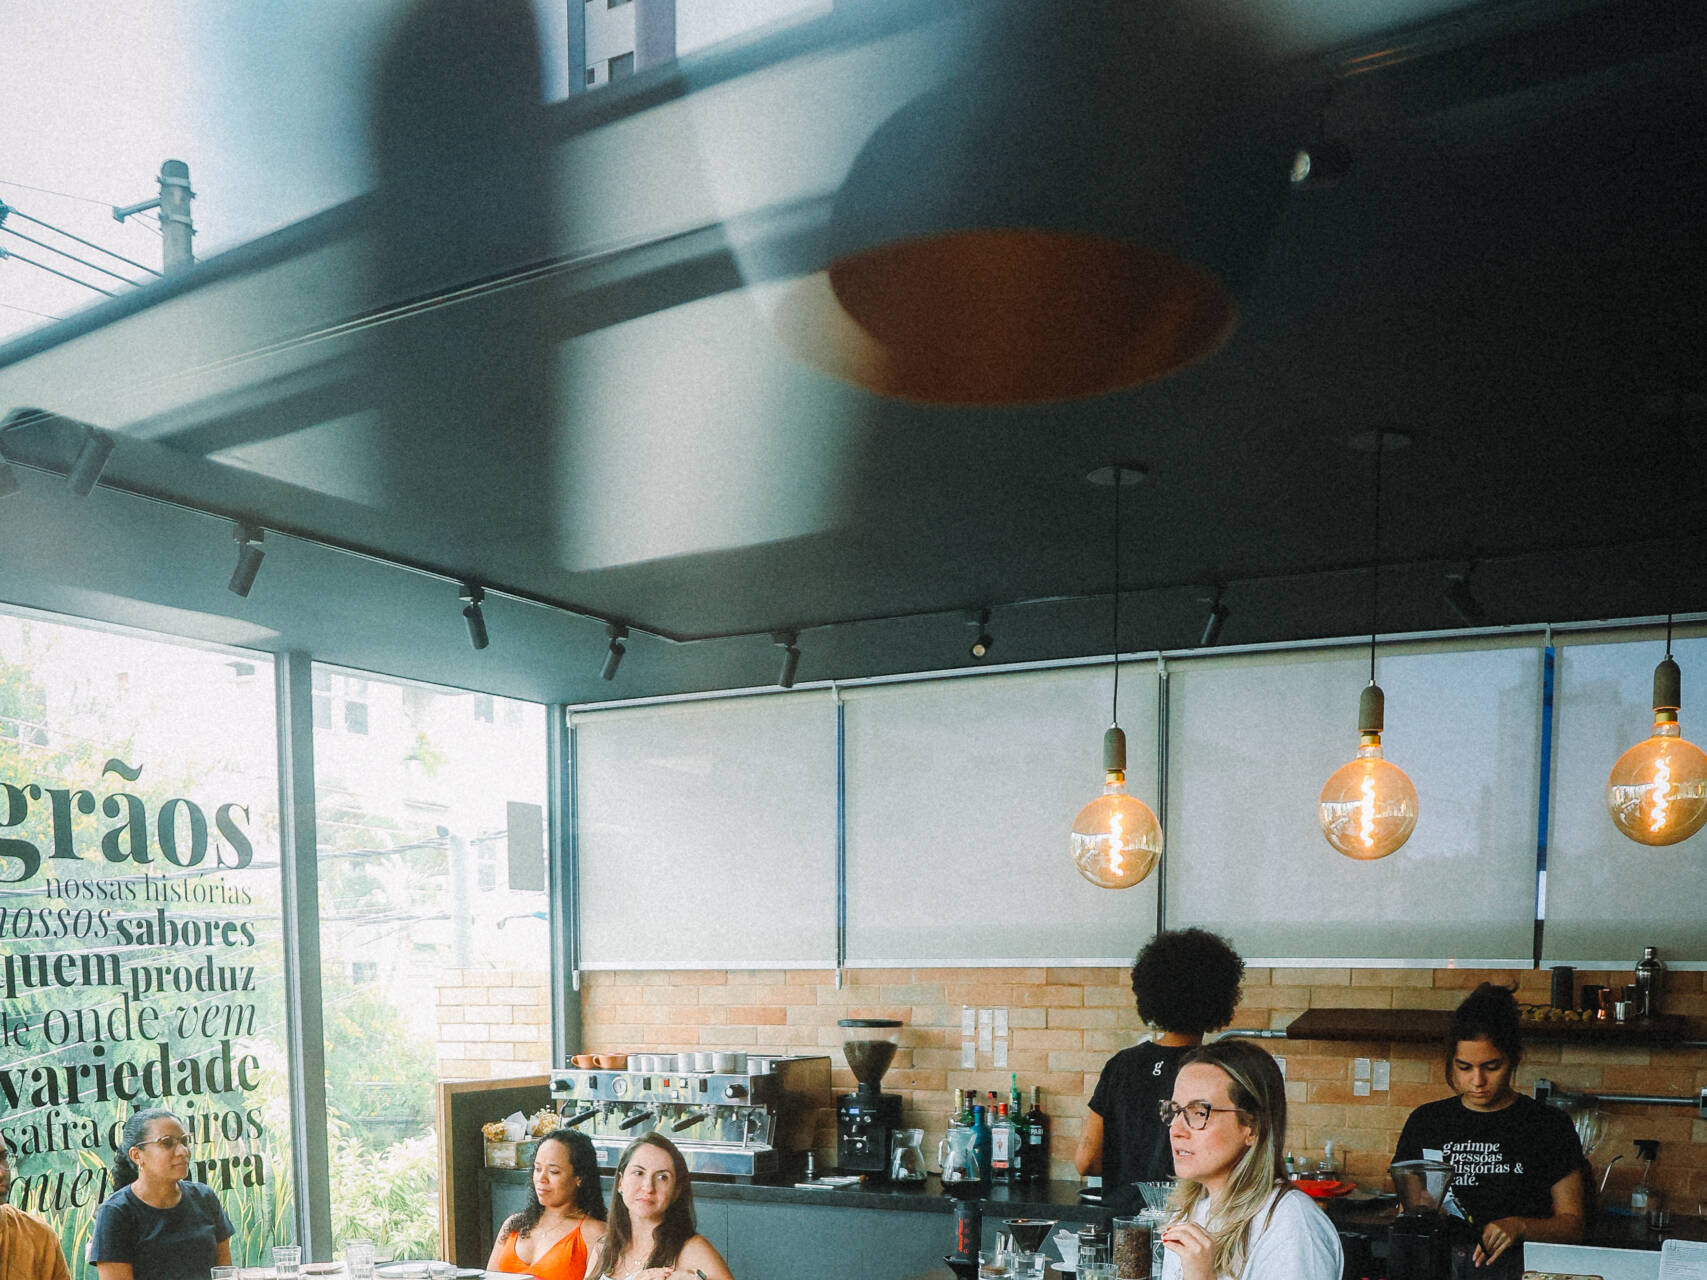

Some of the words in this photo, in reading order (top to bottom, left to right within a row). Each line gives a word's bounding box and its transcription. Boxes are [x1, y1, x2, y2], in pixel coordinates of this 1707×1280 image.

[46, 877, 137, 901] nossas
[145, 873, 252, 905] histórias
[0, 906, 111, 939] ossos
[116, 908, 256, 948] sabores
[130, 954, 256, 1002] produz
[43, 992, 161, 1046] onde
[176, 1003, 257, 1040] vem
[0, 1039, 261, 1110] variedade
[1, 1109, 101, 1156] safra
[1450, 1152, 1503, 1166] pessoas
[1513, 1162, 1524, 1174] &
